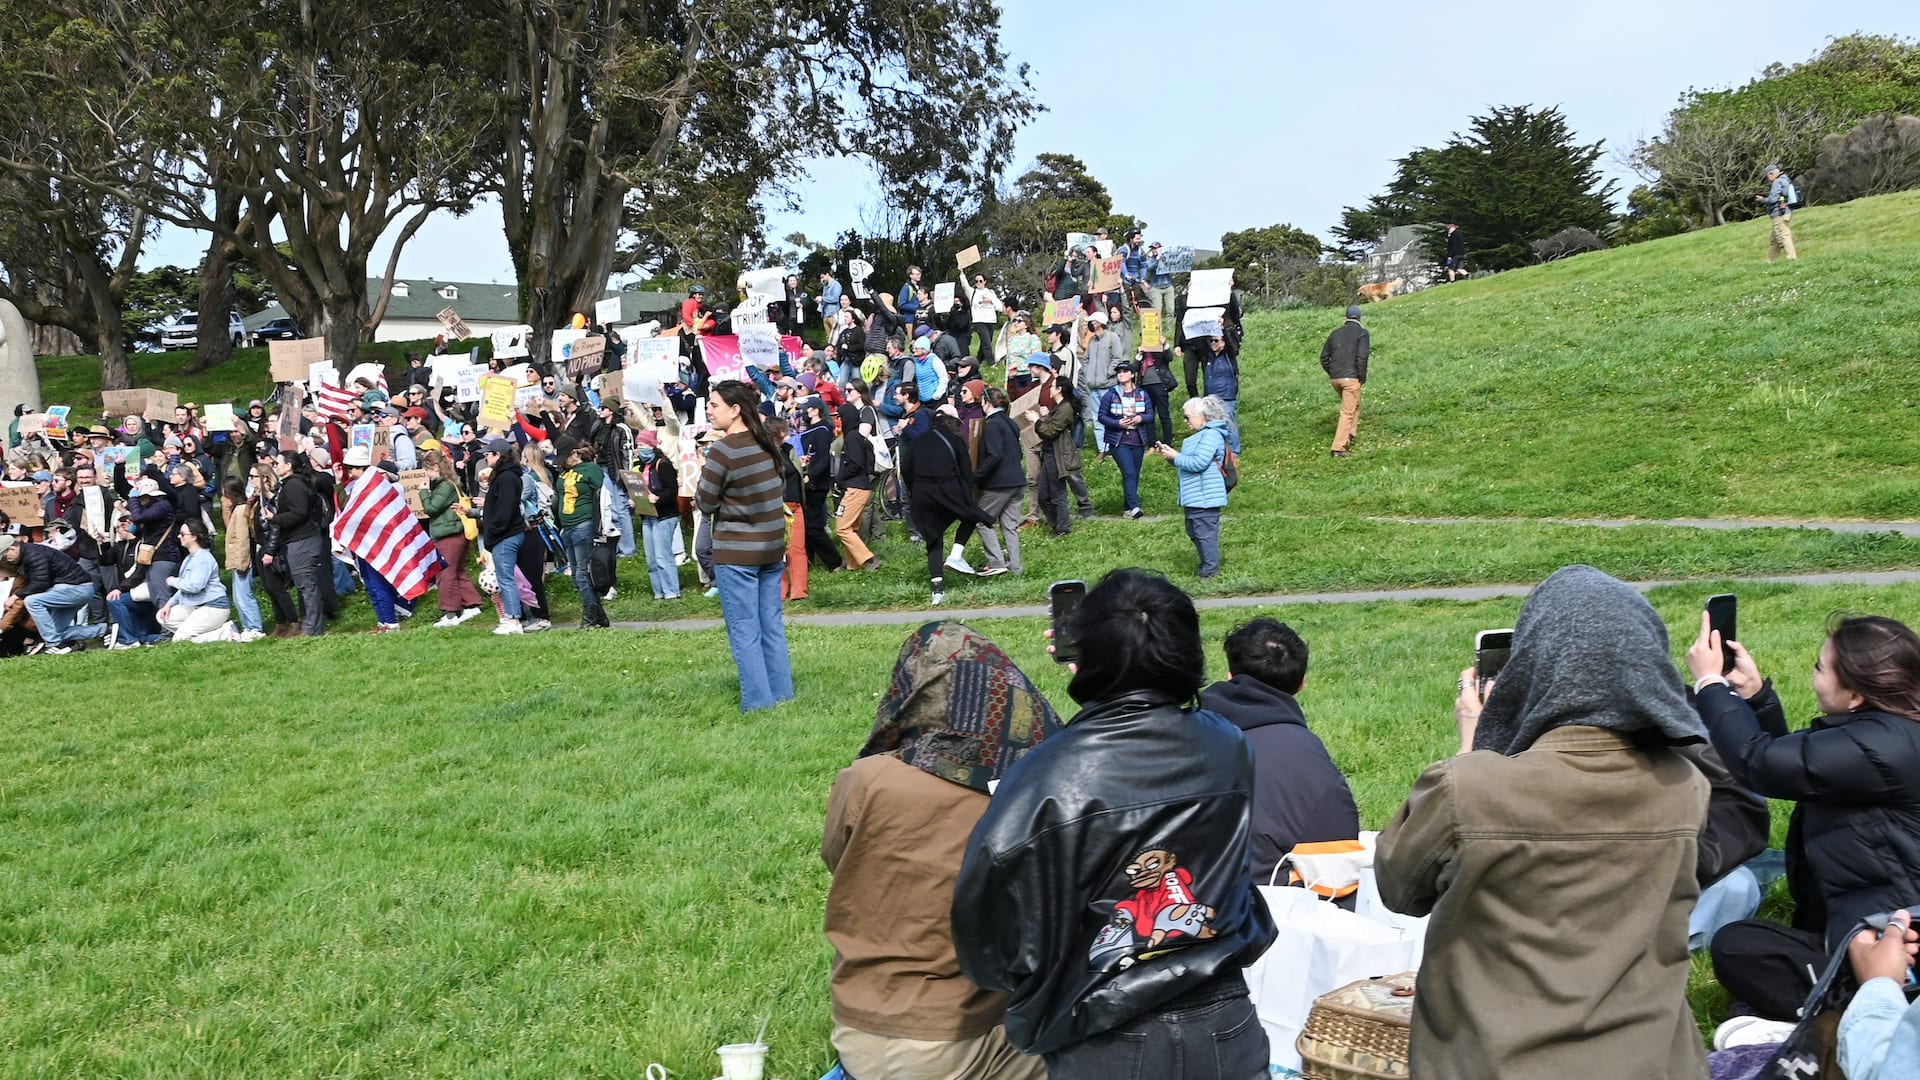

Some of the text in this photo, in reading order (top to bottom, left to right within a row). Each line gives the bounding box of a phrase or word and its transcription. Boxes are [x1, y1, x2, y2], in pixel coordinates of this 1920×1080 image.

[1102, 259, 1122, 273] SAVE
[640, 339, 673, 352] PROTECT
[567, 358, 581, 374] NO
[460, 388, 471, 397] TO
[373, 430, 388, 447] OUR
[400, 471, 426, 481] ANGEROUS
